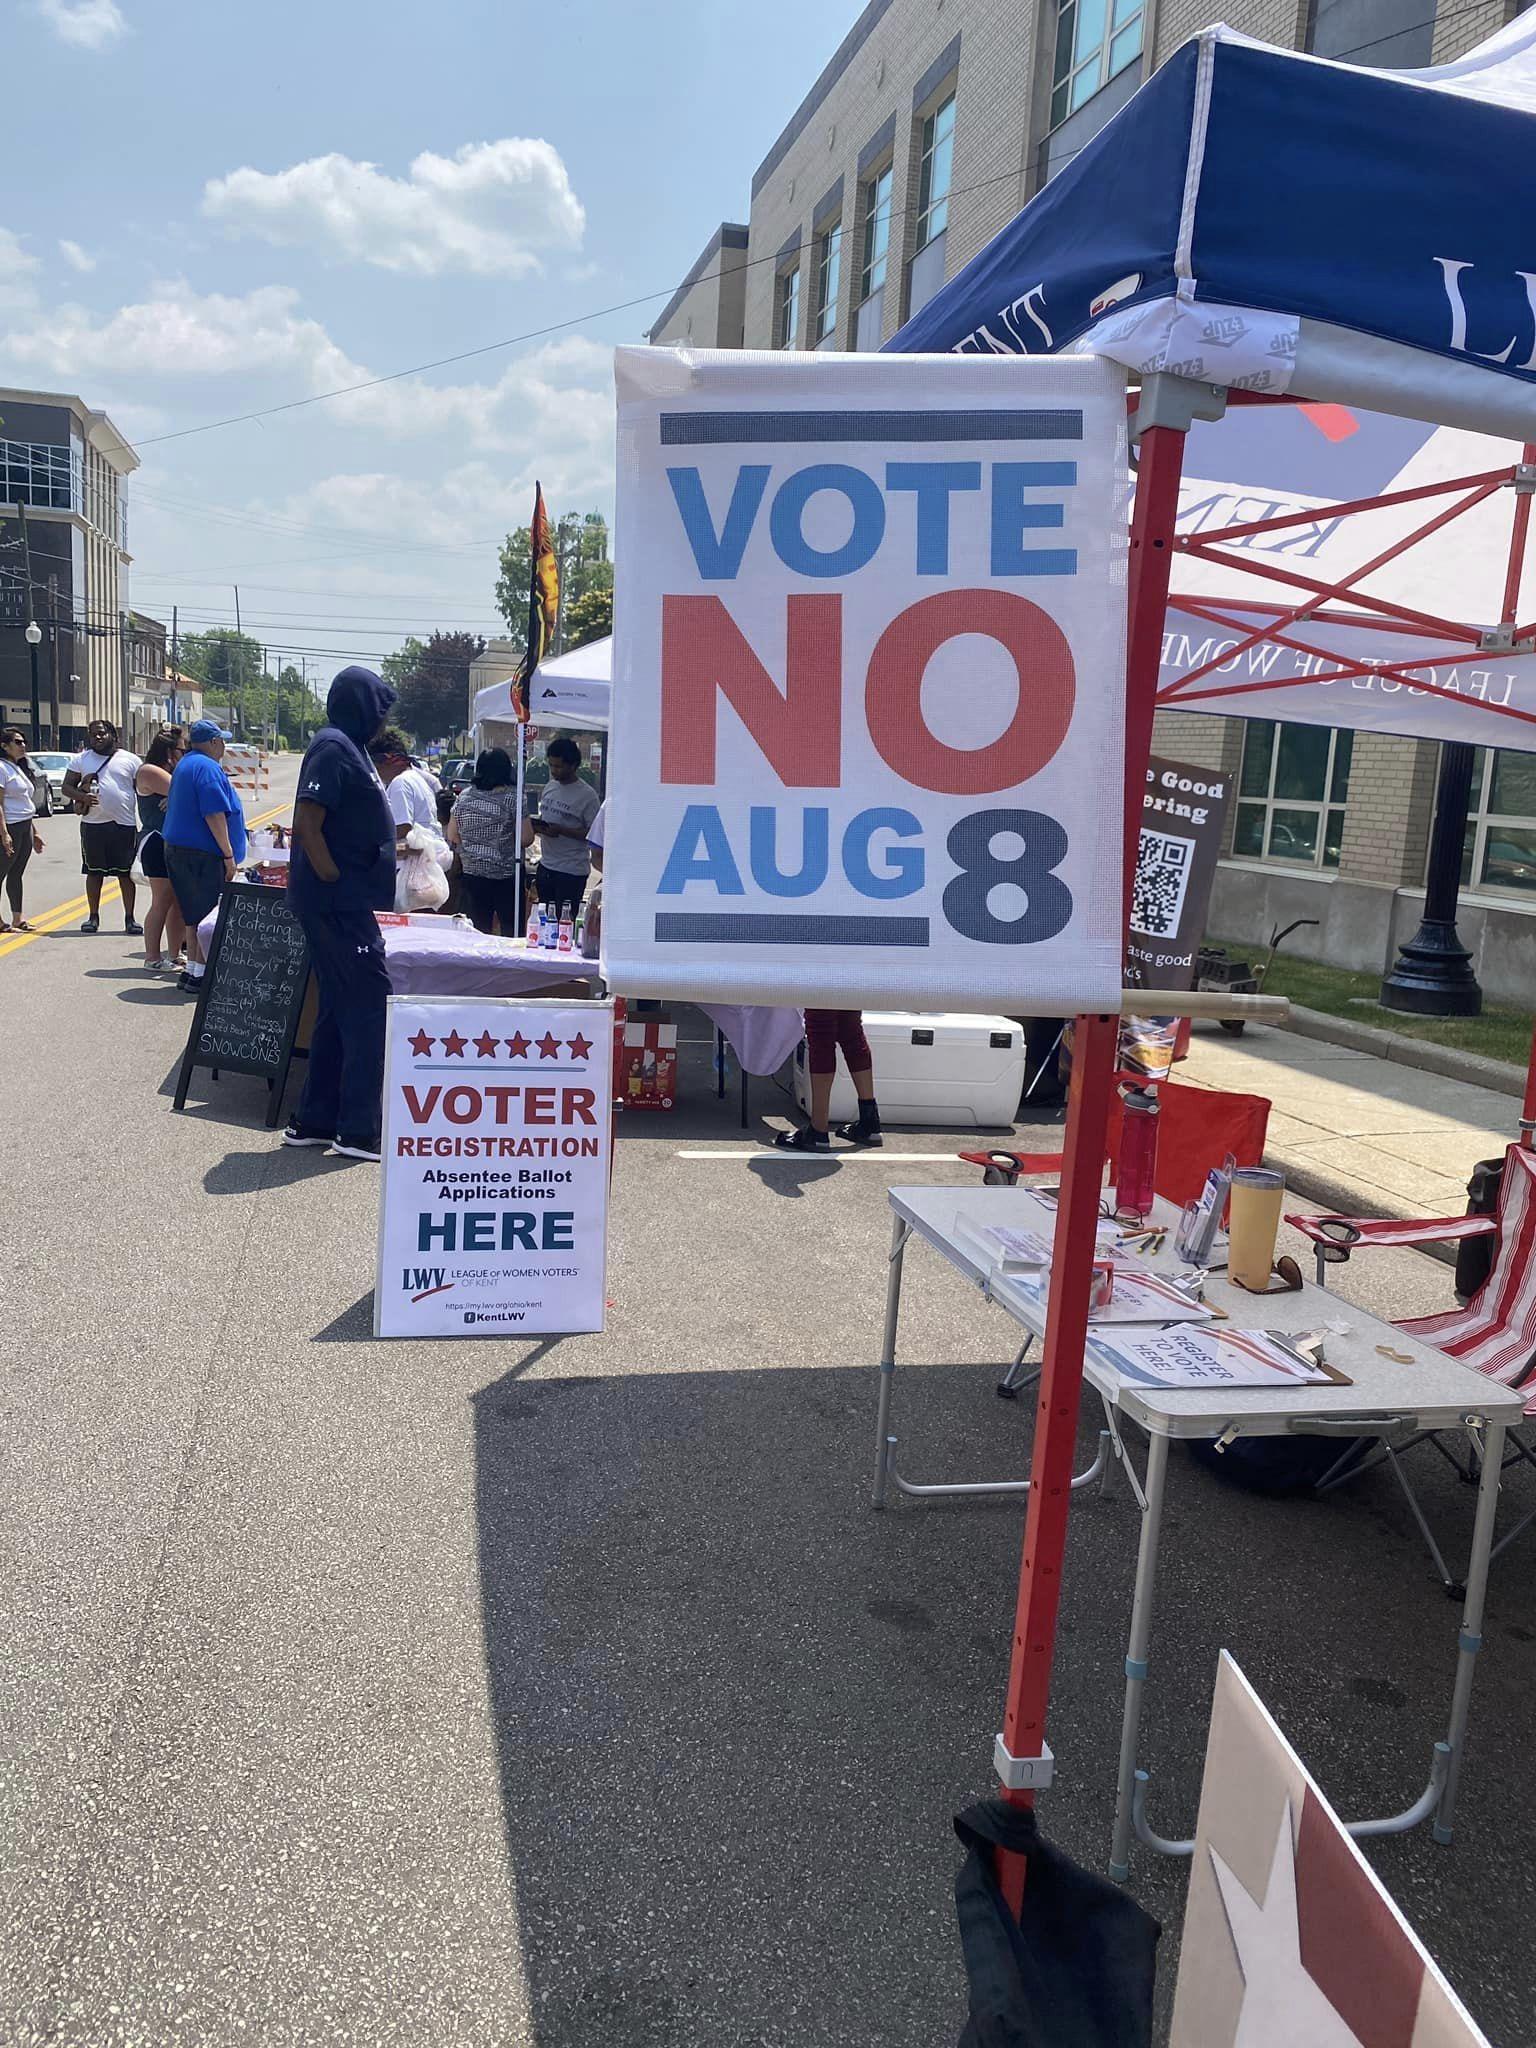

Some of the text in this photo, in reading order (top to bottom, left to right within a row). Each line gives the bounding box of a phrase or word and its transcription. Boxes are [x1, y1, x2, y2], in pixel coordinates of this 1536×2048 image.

[666, 461, 1077, 580] VOTE
[660, 588, 1076, 796] NO
[1161, 771, 1224, 799] Good
[1143, 794, 1209, 825] ering
[655, 805, 1073, 945] AUG 8
[233, 894, 267, 916] Taste
[238, 913, 292, 942] Catering
[1127, 944, 1192, 968] aste good
[200, 1033, 281, 1065] SNOWCONES
[401, 1085, 597, 1125] VOTER
[397, 1137, 599, 1157] REGISTRATION
[423, 1170, 572, 1183] Absentee Ballot
[438, 1186, 556, 1202] Applications
[418, 1212, 574, 1251] HERE
[402, 1268, 446, 1290] LWV
[451, 1269, 489, 1279] LEAGUE
[503, 1268, 540, 1278] WOMEN
[461, 1278, 499, 1287] OF KENT
[476, 1312, 526, 1322] KentLWV
[1132, 1344, 1177, 1372] HERE!
[1150, 1337, 1209, 1378] TO VOTE
[1171, 1335, 1235, 1380] REGISTER
